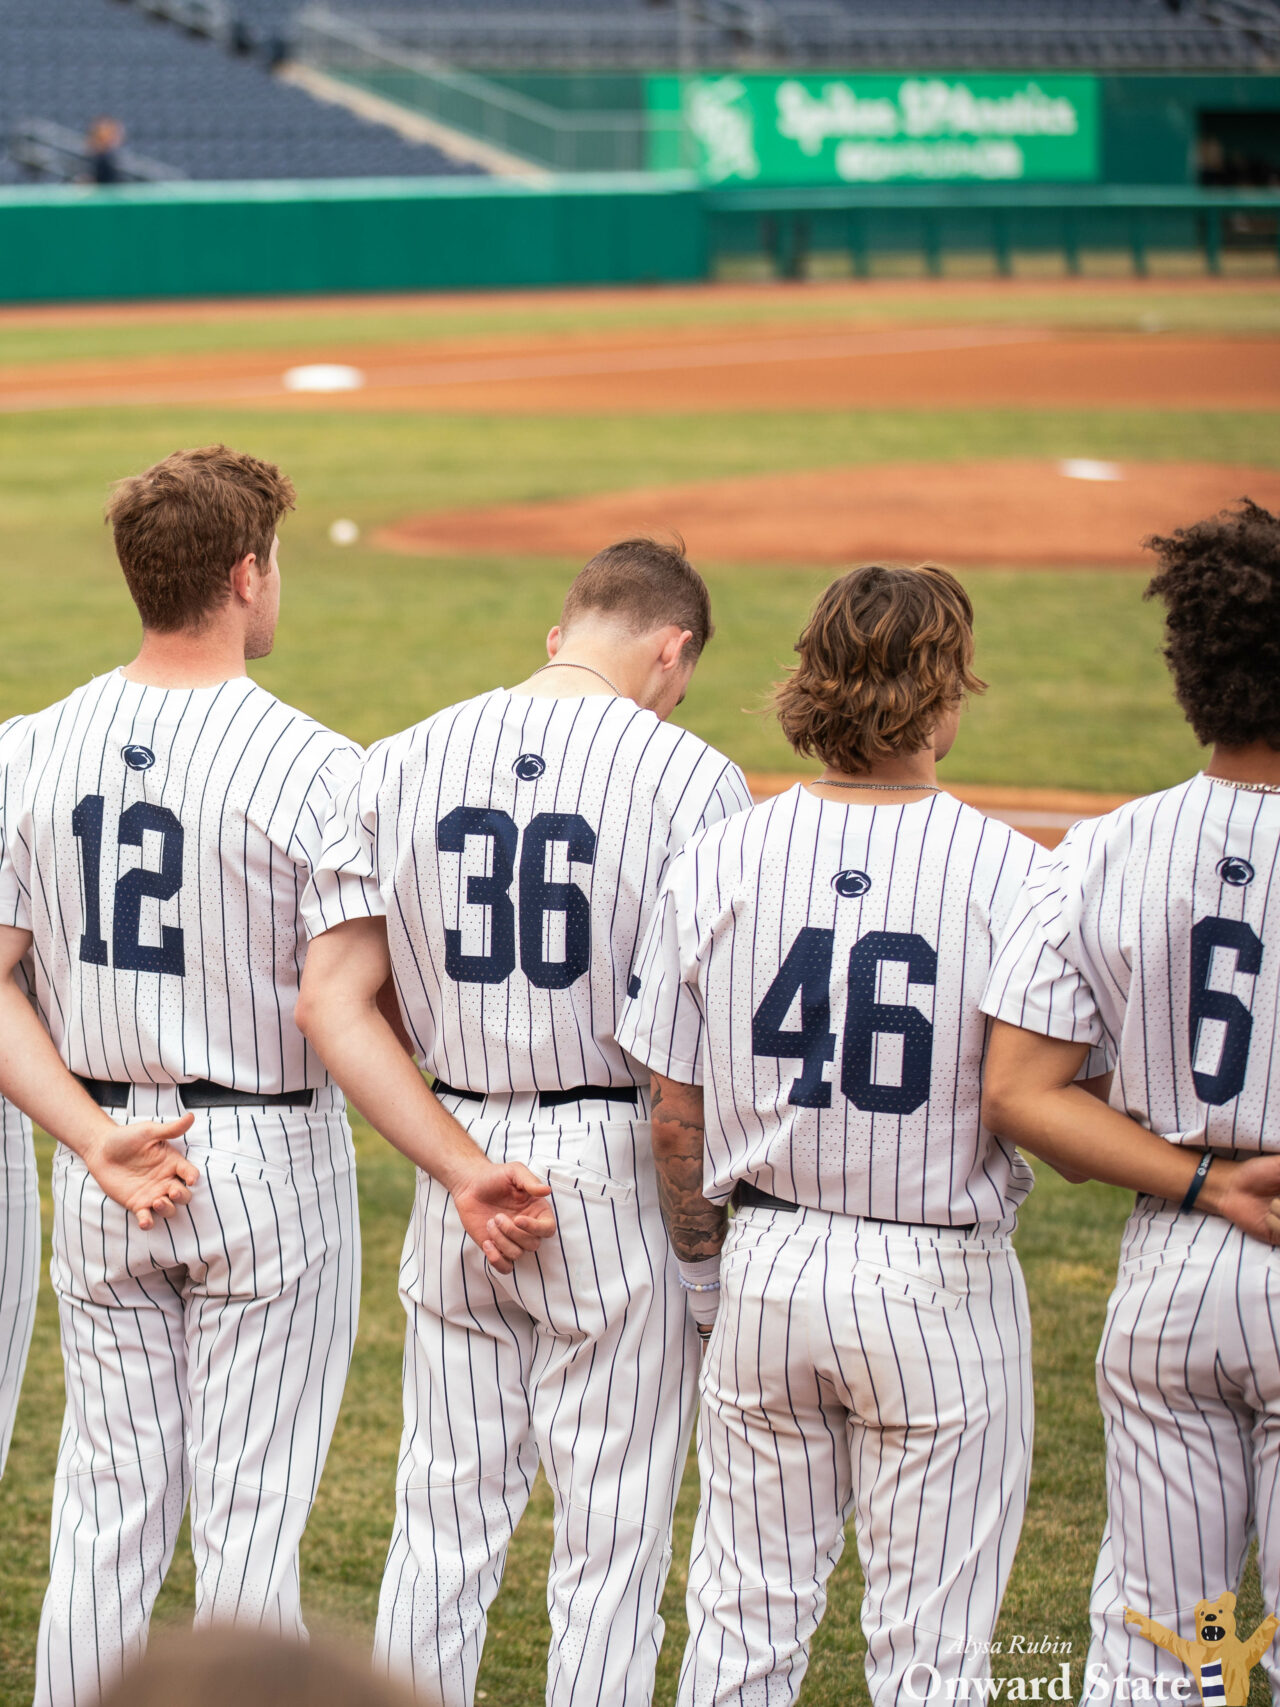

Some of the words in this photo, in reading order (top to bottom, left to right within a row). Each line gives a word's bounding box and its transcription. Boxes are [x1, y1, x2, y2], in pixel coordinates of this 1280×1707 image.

[71, 794, 186, 977] 12
[437, 806, 596, 989] 36
[752, 927, 937, 1115] 46
[1189, 915, 1264, 1105] 6
